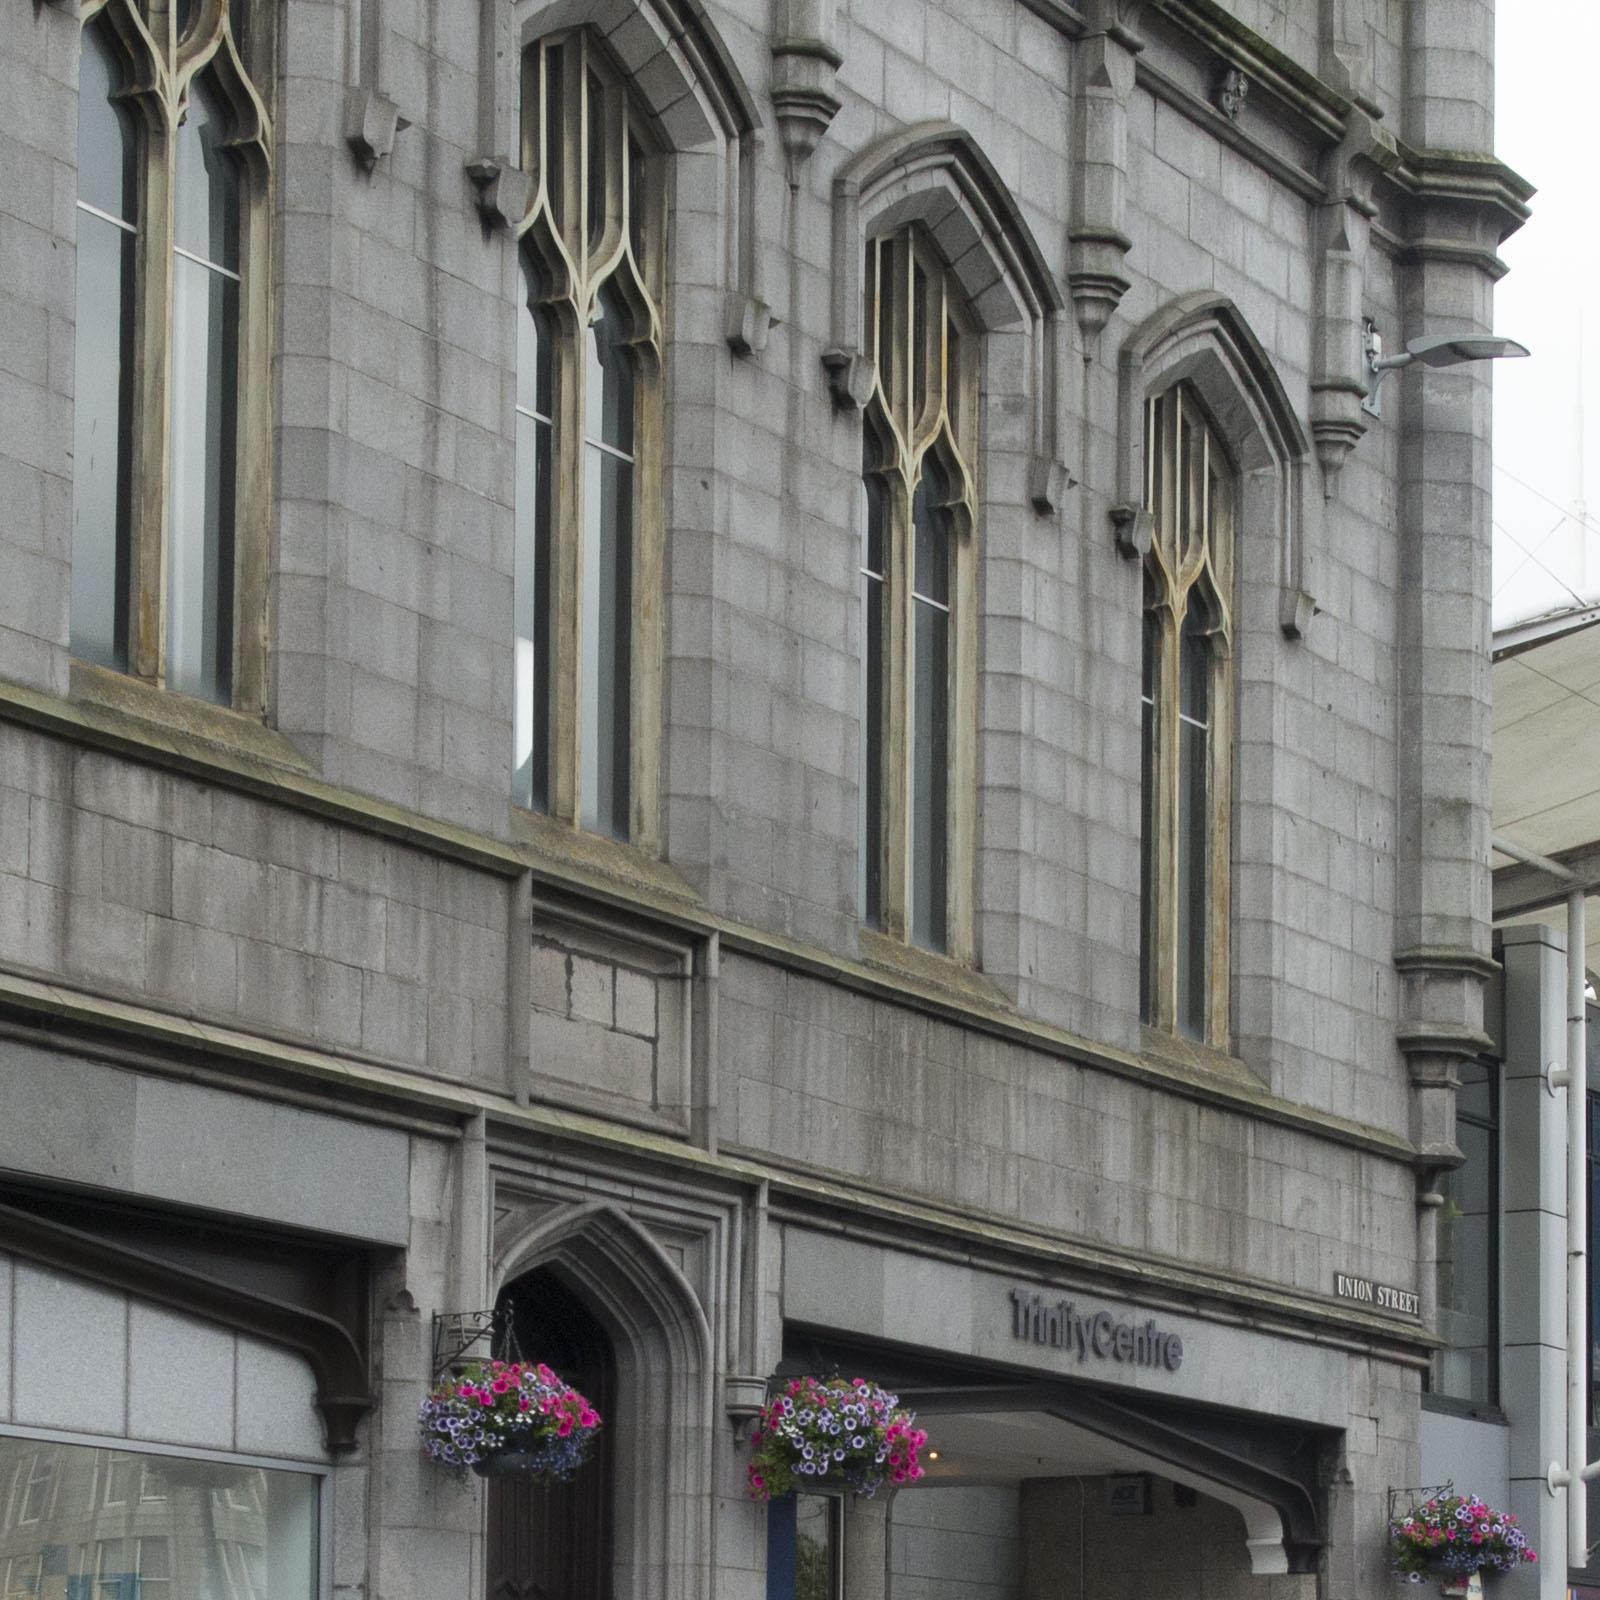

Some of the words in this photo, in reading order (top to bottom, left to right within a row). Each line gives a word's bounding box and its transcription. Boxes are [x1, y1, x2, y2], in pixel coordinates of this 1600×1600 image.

[1338, 1275, 1373, 1302] UNION
[1377, 1286, 1420, 1315] STREET
[1010, 1288, 1183, 1371] TrinityCentre
